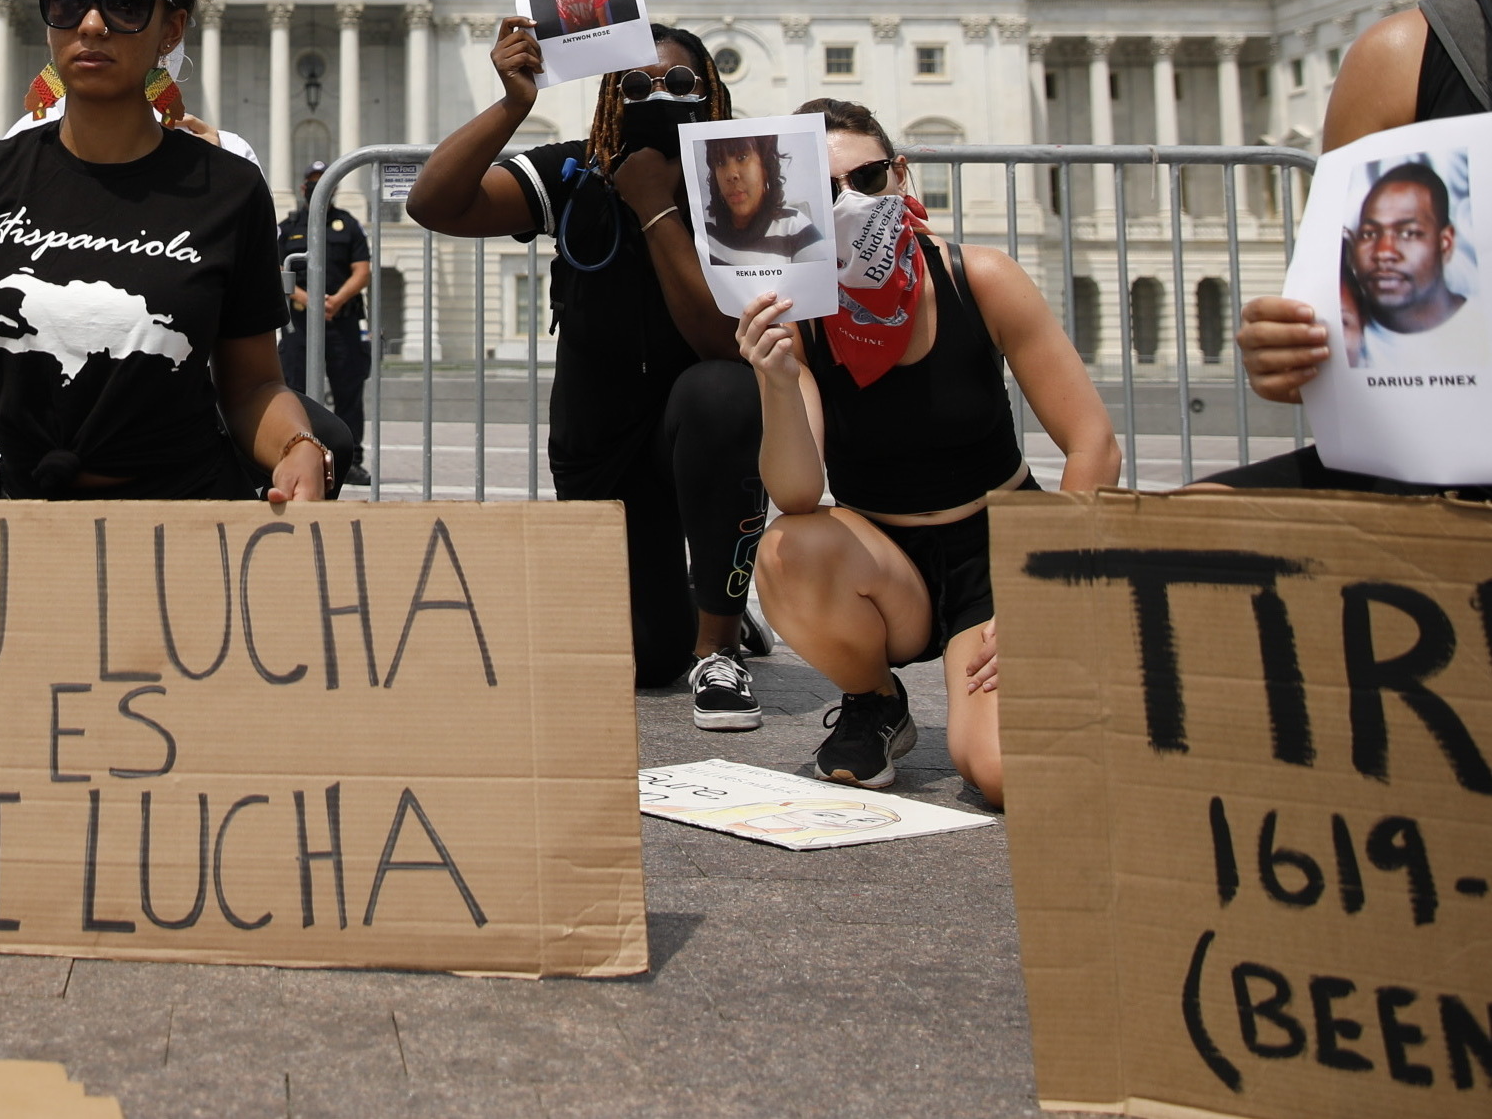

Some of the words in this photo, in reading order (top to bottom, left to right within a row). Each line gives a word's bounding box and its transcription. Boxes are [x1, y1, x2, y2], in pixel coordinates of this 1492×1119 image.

[562, 34, 591, 44] ANTWON
[593, 29, 611, 38] ROSE
[759, 269, 783, 277] BOYD
[1366, 376, 1425, 388] DARIUS
[1429, 375, 1477, 387] PINEX
[95, 516, 498, 691] LUCHA
[1021, 548, 1492, 796] TIR
[50, 682, 177, 782] ES
[81, 781, 489, 934] LUCHA
